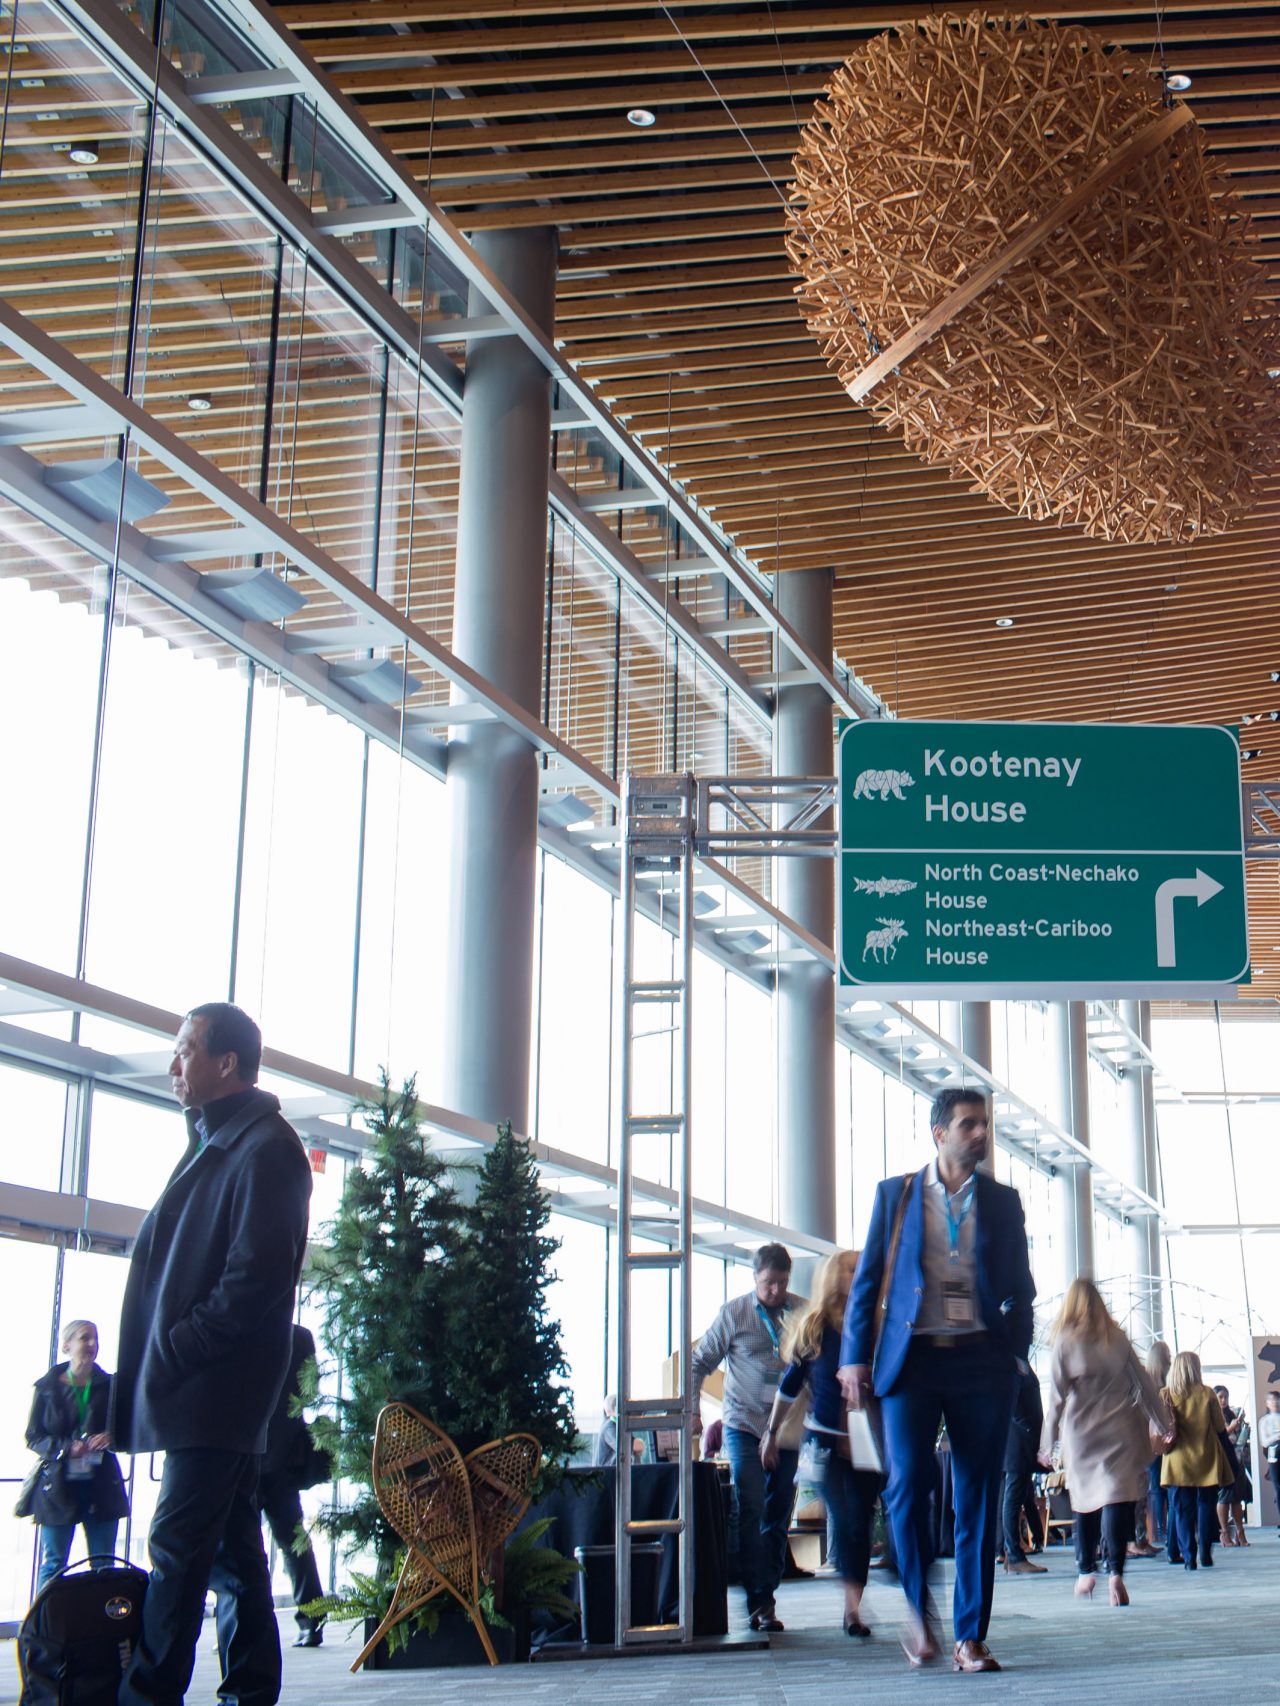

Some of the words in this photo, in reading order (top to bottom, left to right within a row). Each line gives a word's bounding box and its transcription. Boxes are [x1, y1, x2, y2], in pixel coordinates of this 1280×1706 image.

[925, 749, 1081, 786] Kootenay
[926, 795, 1026, 822] House
[926, 864, 982, 880] North
[990, 864, 1139, 881] Coast-Nechako
[926, 892, 987, 908] House
[926, 920, 1112, 936] Northeast-Cariboo
[927, 948, 988, 964] House
[118, 1638, 131, 1671] THU
